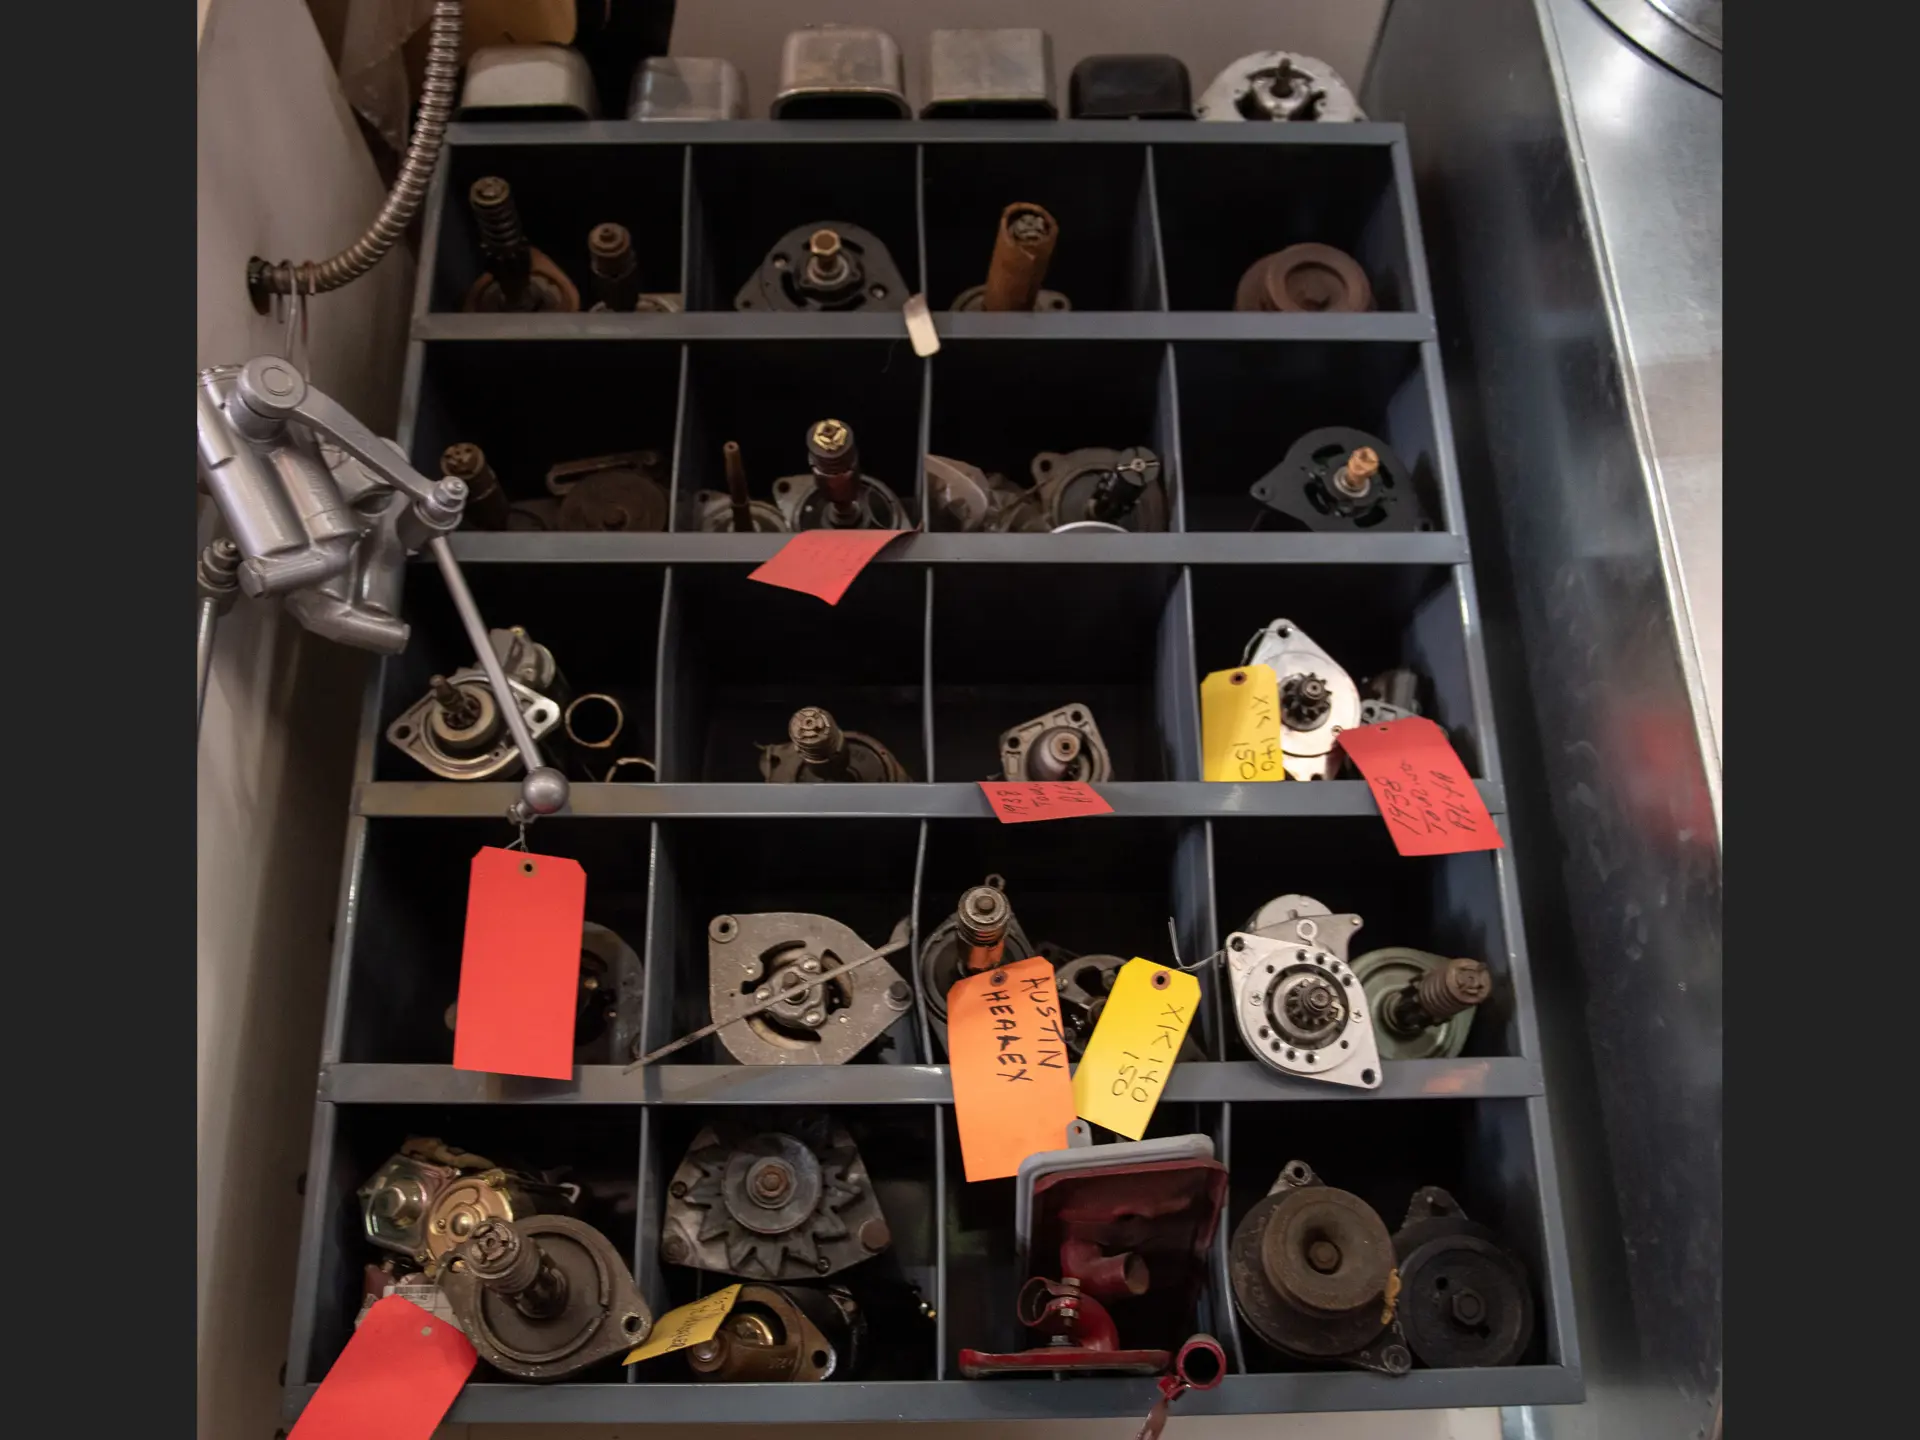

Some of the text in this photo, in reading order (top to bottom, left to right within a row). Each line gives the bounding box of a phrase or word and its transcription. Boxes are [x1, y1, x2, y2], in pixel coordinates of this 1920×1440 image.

[1231, 742, 1258, 780] 150
[1374, 775, 1422, 835] 1938
[1021, 976, 1066, 1069] AUSTIN
[1112, 1051, 1139, 1096] 150
